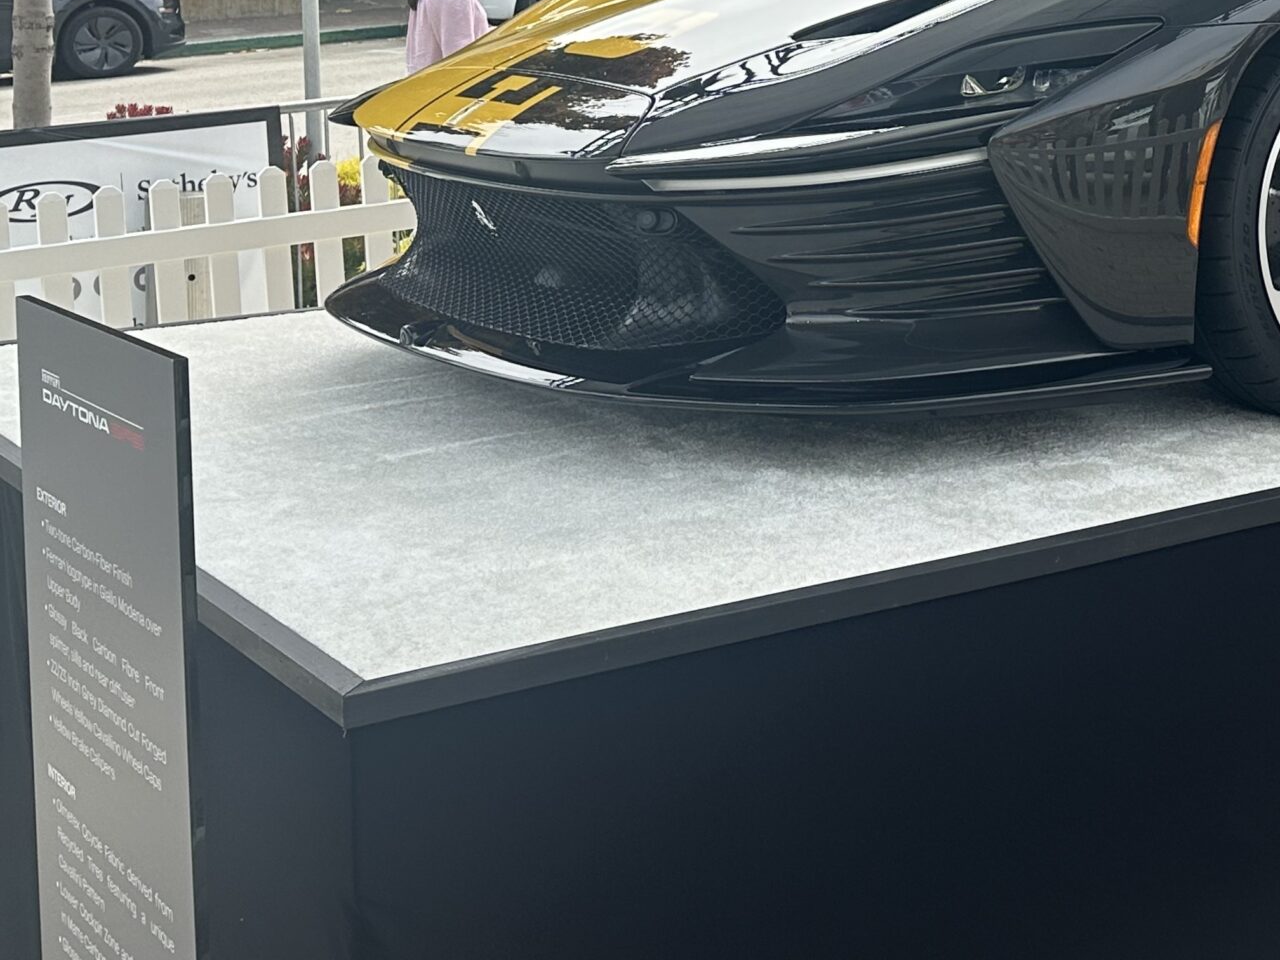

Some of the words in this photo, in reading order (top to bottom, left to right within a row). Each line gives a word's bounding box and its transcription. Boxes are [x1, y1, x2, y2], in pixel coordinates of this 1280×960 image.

[42, 388, 109, 434] DAYTONA
[36, 487, 66, 516] EXTERIOR
[45, 519, 71, 547] Two-tone
[112, 564, 132, 589] Finish
[46, 548, 65, 571] Ferrari
[118, 597, 144, 627] Modena
[145, 618, 162, 640] over
[47, 576, 65, 600] Upper
[65, 588, 80, 612] Body
[71, 621, 88, 642] Black
[92, 638, 117, 664] Carbon
[121, 658, 139, 681] Fibre
[144, 676, 164, 700] Front
[82, 658, 94, 675] and
[95, 669, 109, 687] rear
[109, 678, 135, 709] diffuser
[51, 687, 73, 713] Wheels
[121, 746, 143, 774] Wheel
[143, 765, 161, 791] Caps
[81, 685, 96, 708] Grey
[97, 698, 126, 731] Diamond
[127, 722, 140, 742] Cut
[141, 732, 167, 766] Forged
[47, 763, 76, 798] INTERIOR
[57, 826, 84, 864] Recycled
[87, 855, 103, 880] Tires
[107, 875, 137, 916] featuring
[151, 920, 175, 953] unique
[59, 882, 78, 910] Lower
[79, 902, 102, 936] Cockpit
[104, 928, 120, 954] Zone
[126, 866, 153, 902] derived
[154, 893, 173, 921] from
